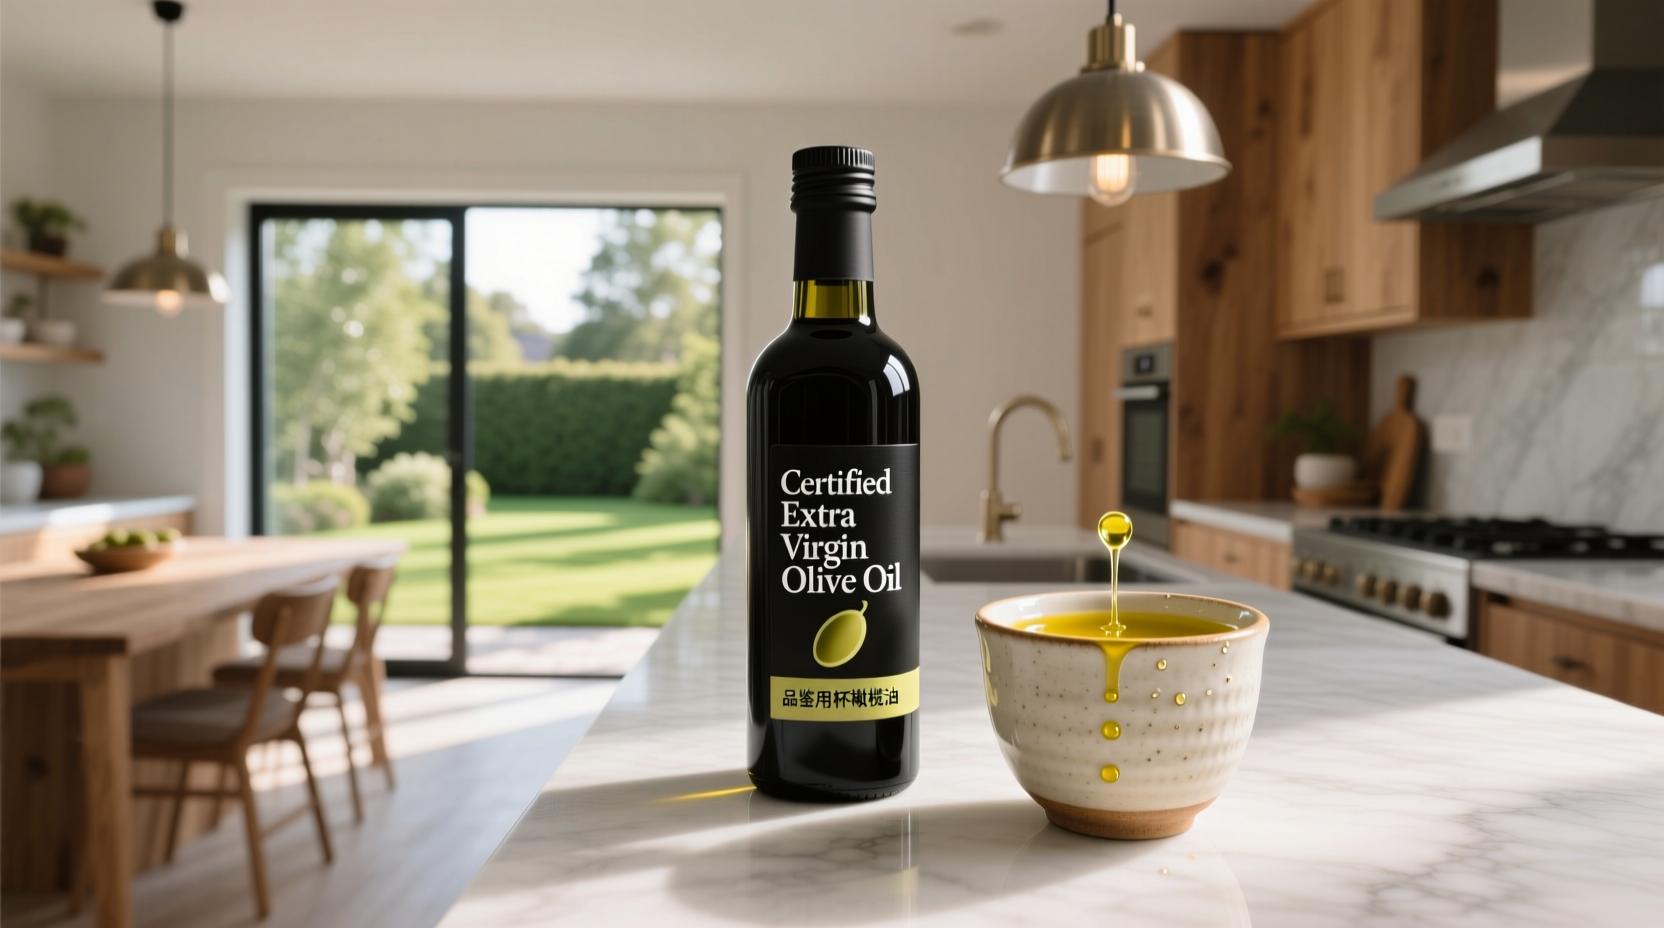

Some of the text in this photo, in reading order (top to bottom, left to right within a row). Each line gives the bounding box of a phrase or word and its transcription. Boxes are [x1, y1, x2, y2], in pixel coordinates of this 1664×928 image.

[780, 467, 893, 496] Certified
[780, 500, 857, 528] Extra
[780, 533, 870, 570] Virgin
[781, 561, 903, 594] Olive Oil
